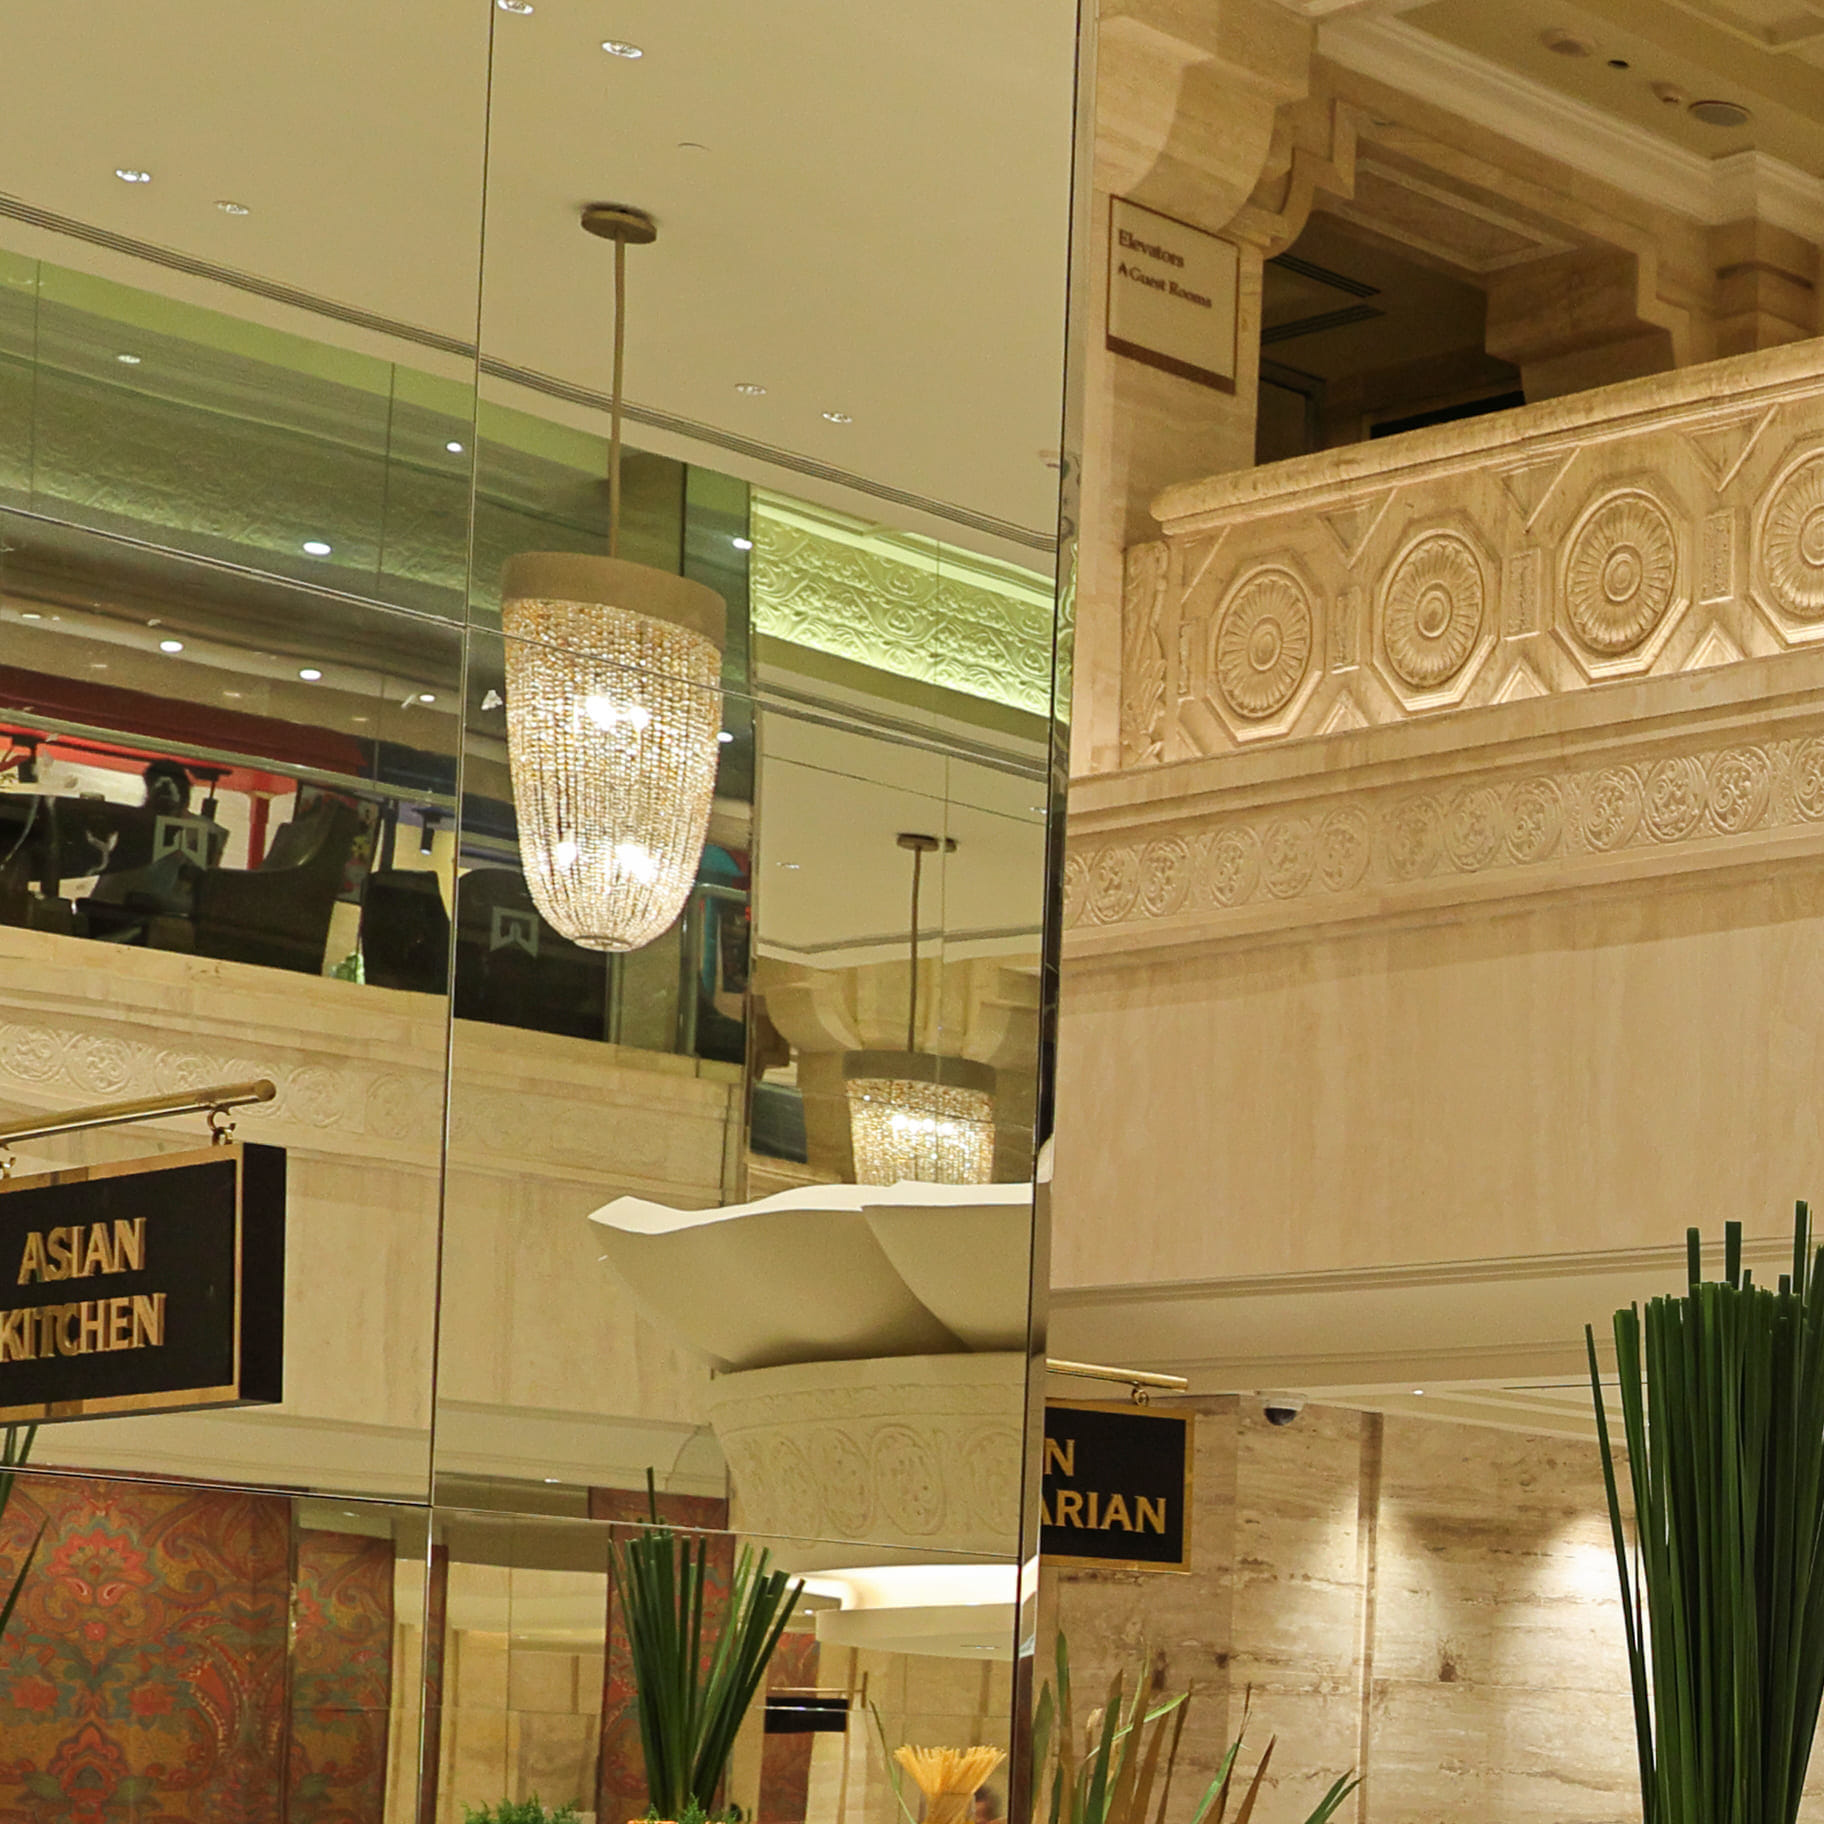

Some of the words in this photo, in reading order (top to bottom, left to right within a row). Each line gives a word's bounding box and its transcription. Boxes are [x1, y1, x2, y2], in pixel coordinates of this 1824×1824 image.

[1119, 229, 1184, 268] Elevators
[1129, 266, 1165, 291] Guest
[1168, 281, 1212, 308] Rooms
[17, 1217, 147, 1285] ASIAN
[0, 1293, 167, 1363] KITCHEN
